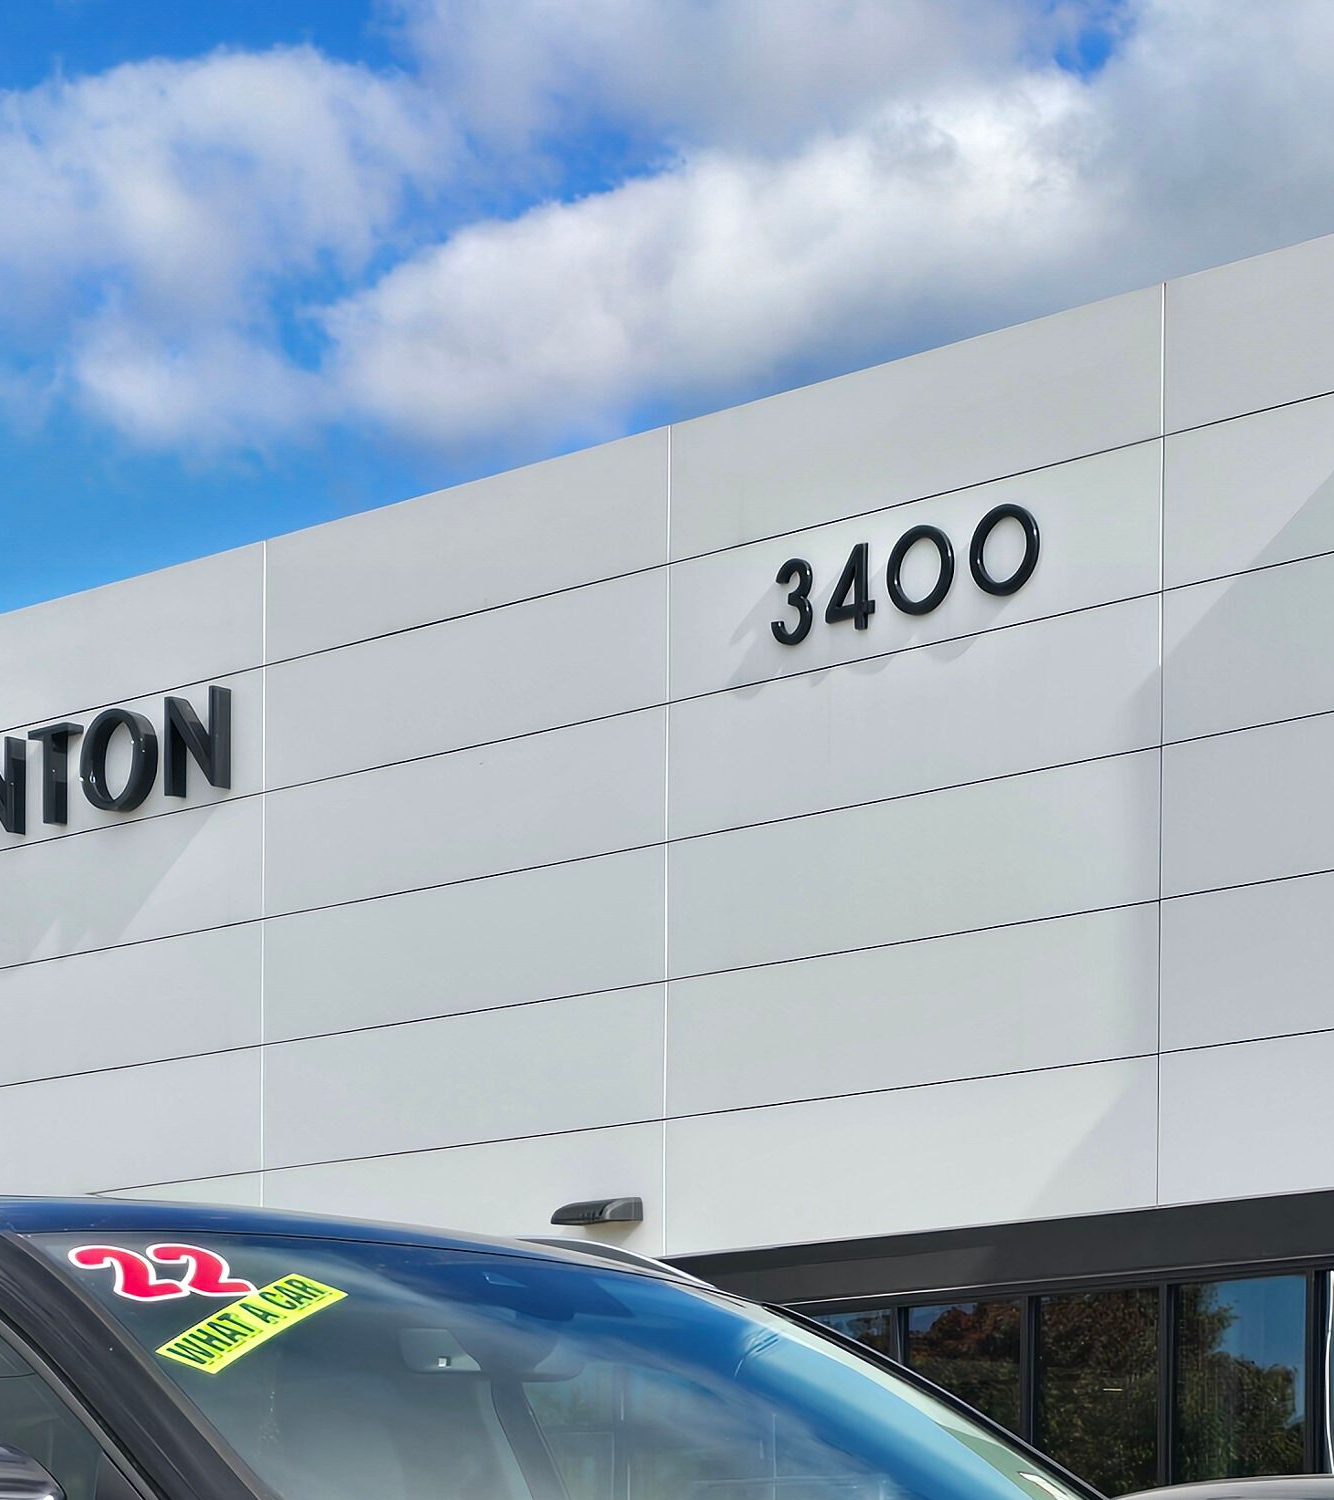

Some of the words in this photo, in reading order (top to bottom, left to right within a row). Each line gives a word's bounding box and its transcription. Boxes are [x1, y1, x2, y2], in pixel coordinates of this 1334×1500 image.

[771, 503, 1040, 646] 3400
[68, 1243, 259, 1301] 22
[259, 1279, 326, 1310] CAR
[166, 1313, 256, 1365] WHAT
[239, 1303, 281, 1324] A
